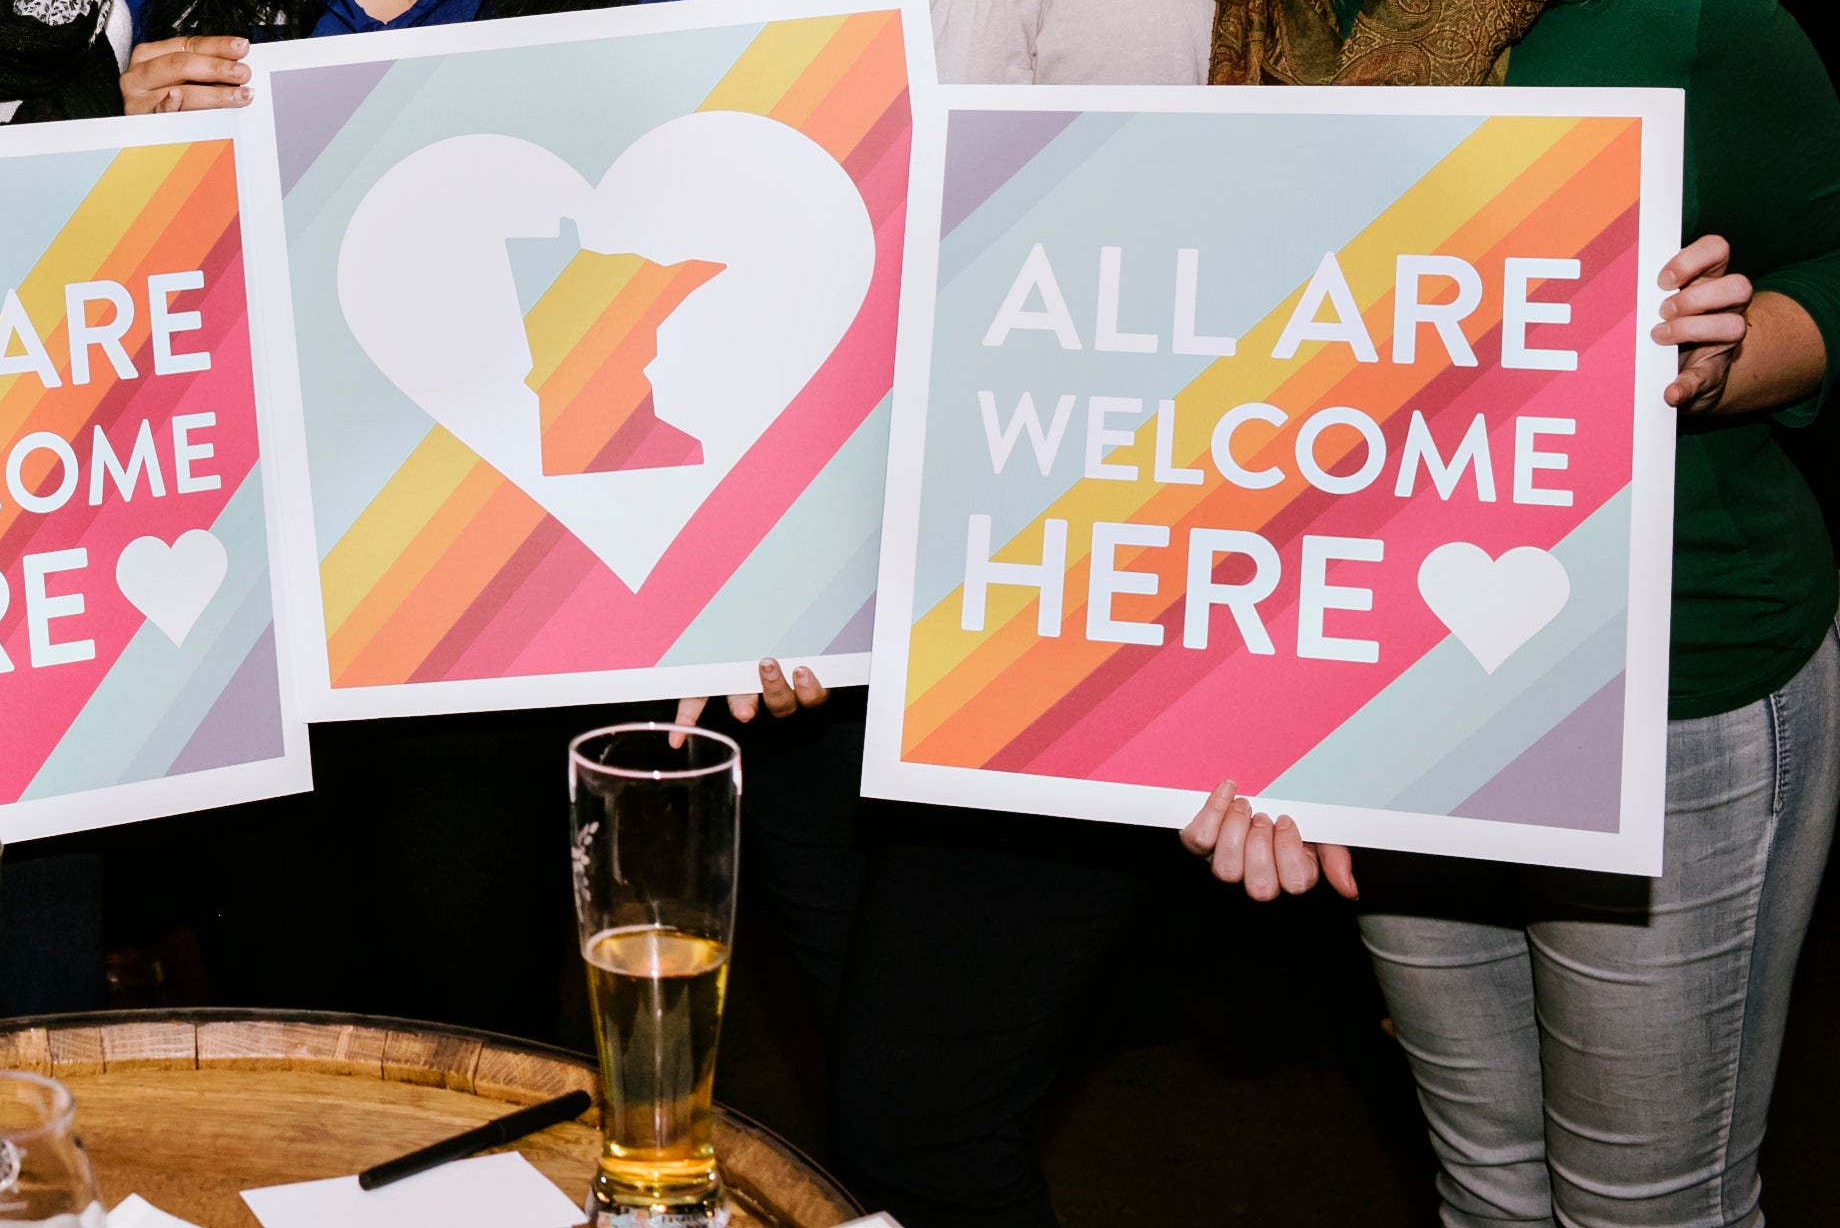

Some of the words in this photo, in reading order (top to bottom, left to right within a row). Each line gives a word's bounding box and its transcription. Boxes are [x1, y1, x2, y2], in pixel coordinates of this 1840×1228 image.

[981, 242, 1237, 357] ALL
[1270, 251, 1581, 372] ARE
[977, 390, 1577, 508] WELCOME
[960, 513, 1385, 665] HERE
